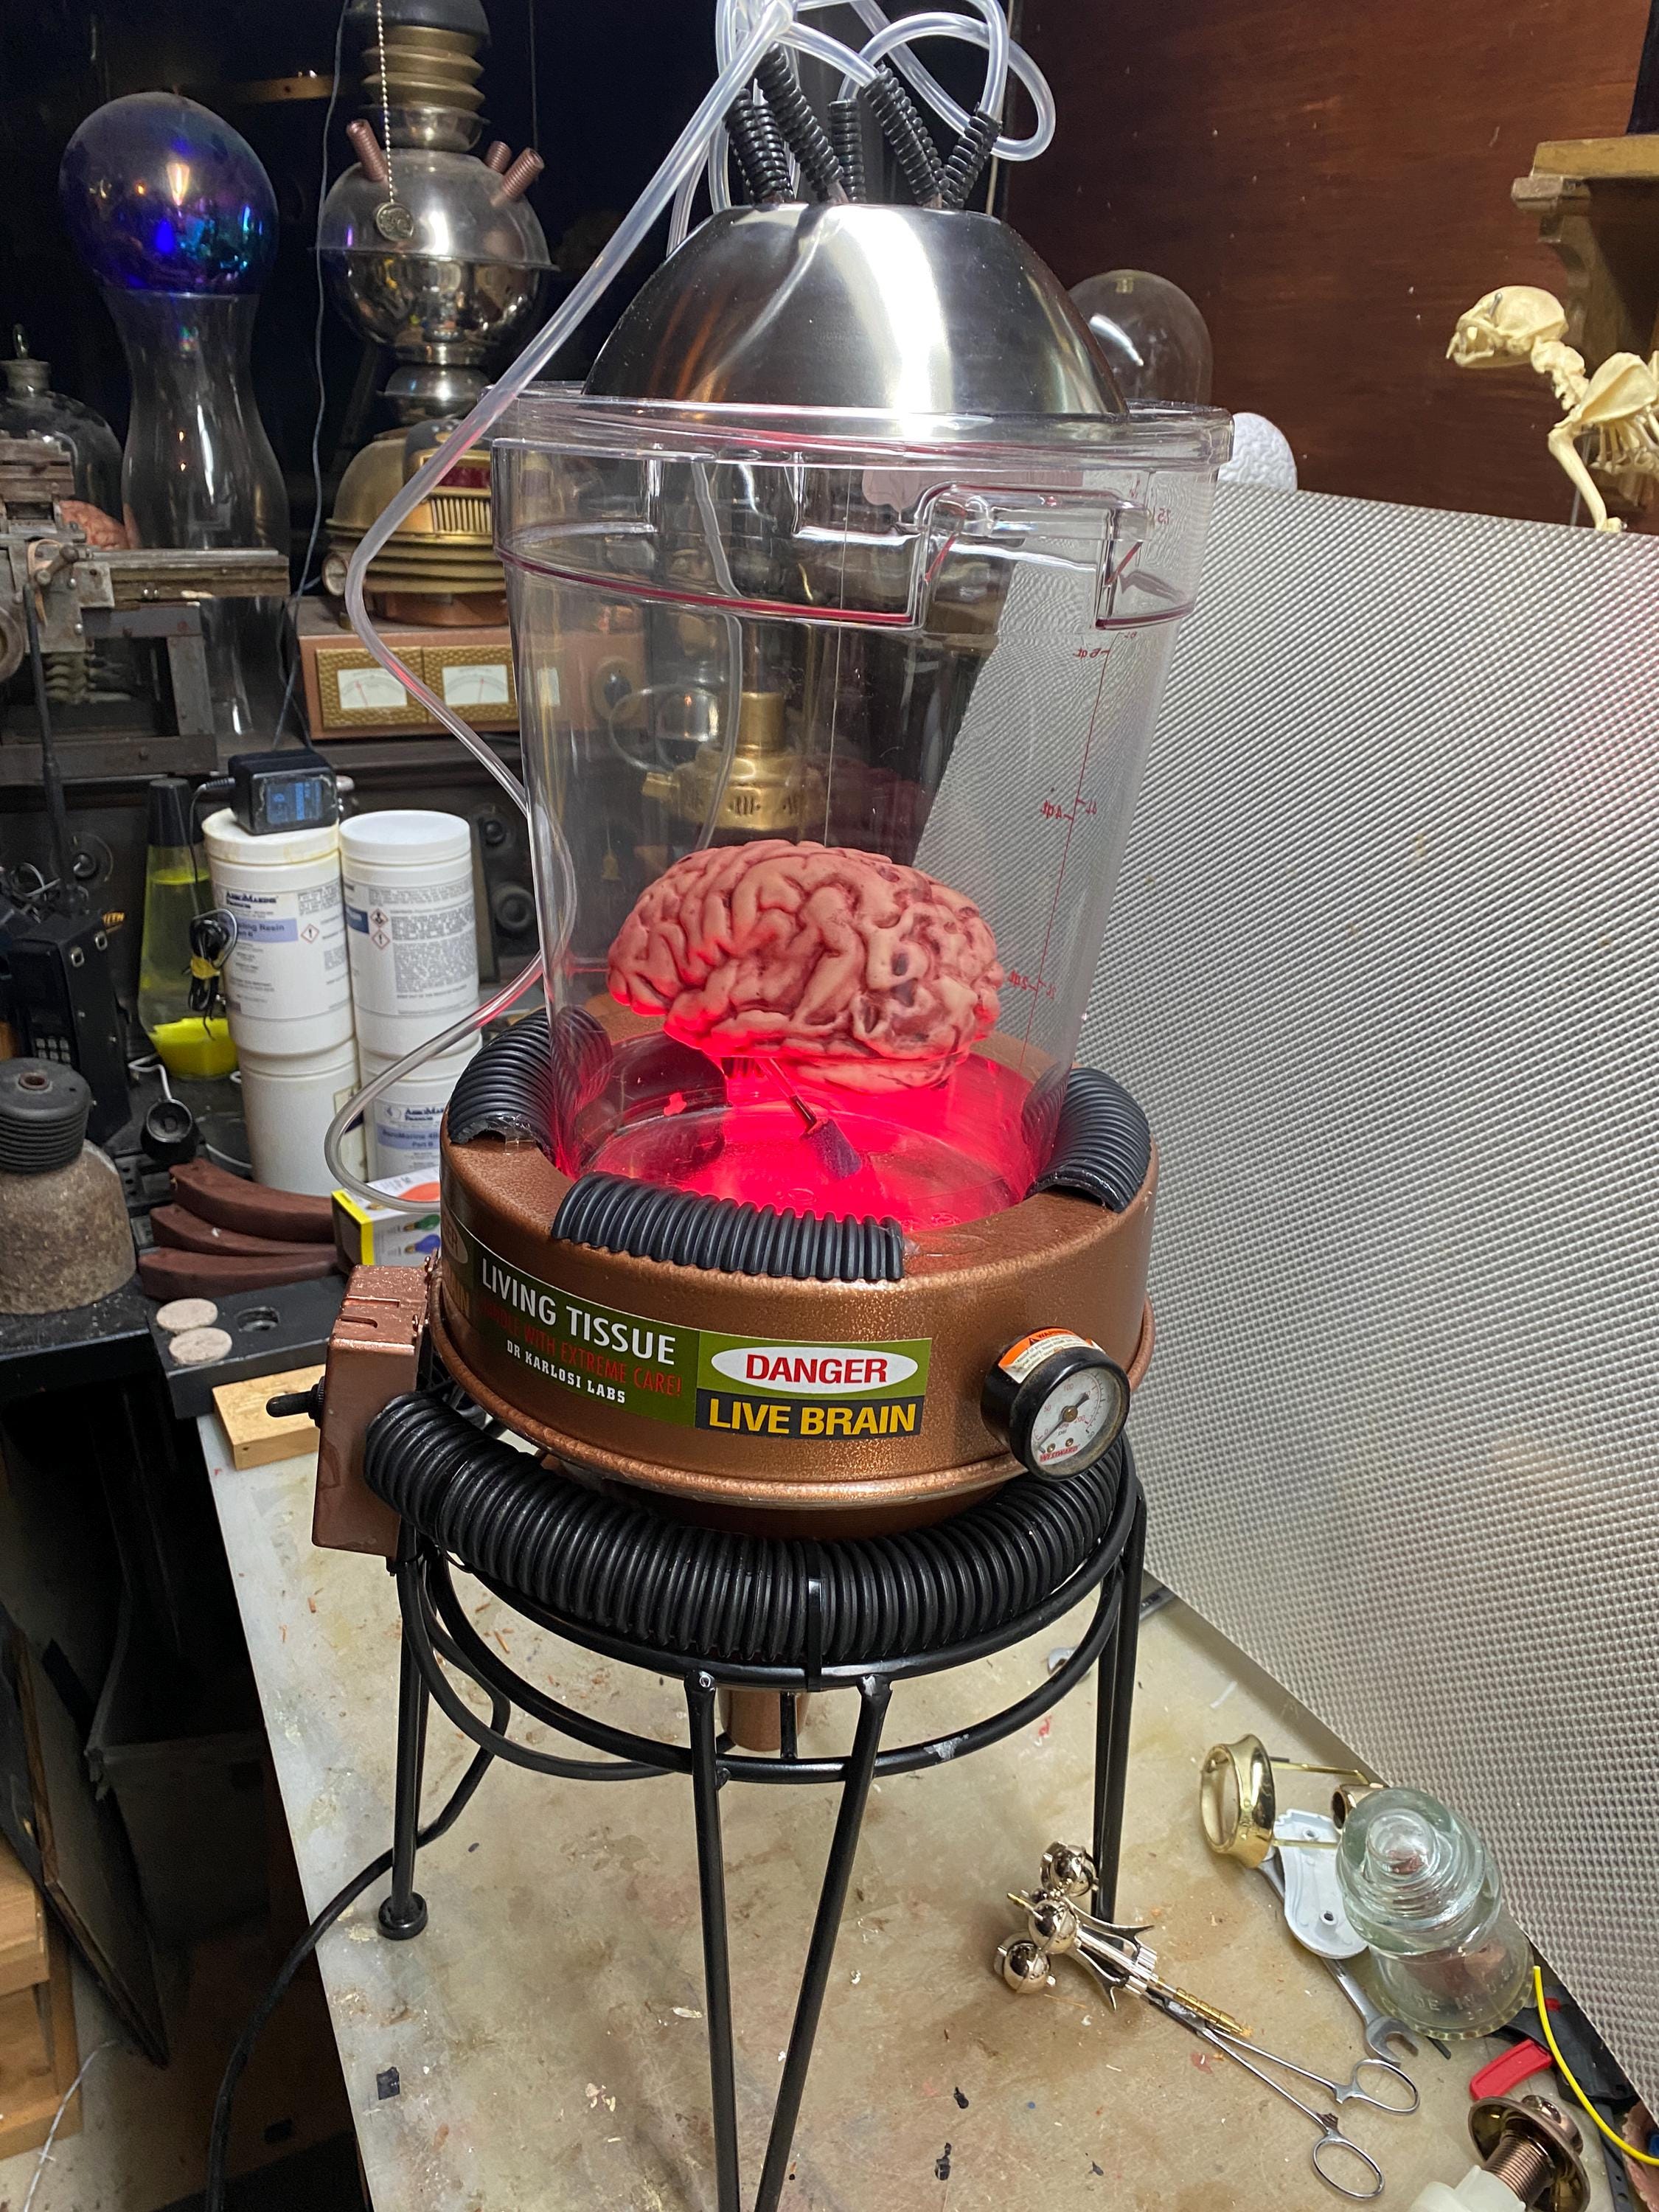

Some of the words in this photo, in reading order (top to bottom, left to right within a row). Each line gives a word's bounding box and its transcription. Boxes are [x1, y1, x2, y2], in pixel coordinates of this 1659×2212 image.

[482, 1257, 557, 1326] LIVING
[566, 1304, 676, 1366] TISSUE
[507, 1339, 521, 1359] DR
[525, 1350, 581, 1389] KARLOSI
[587, 1380, 625, 1404] LABS
[524, 1323, 555, 1357] WITH
[560, 1340, 626, 1384] EXTREME
[633, 1366, 682, 1397] CARE!
[745, 1354, 888, 1384] DANGER
[709, 1397, 791, 1435] LIVE
[800, 1403, 917, 1436] BRAIN
[1039, 1444, 1079, 1463] WESTWARD
